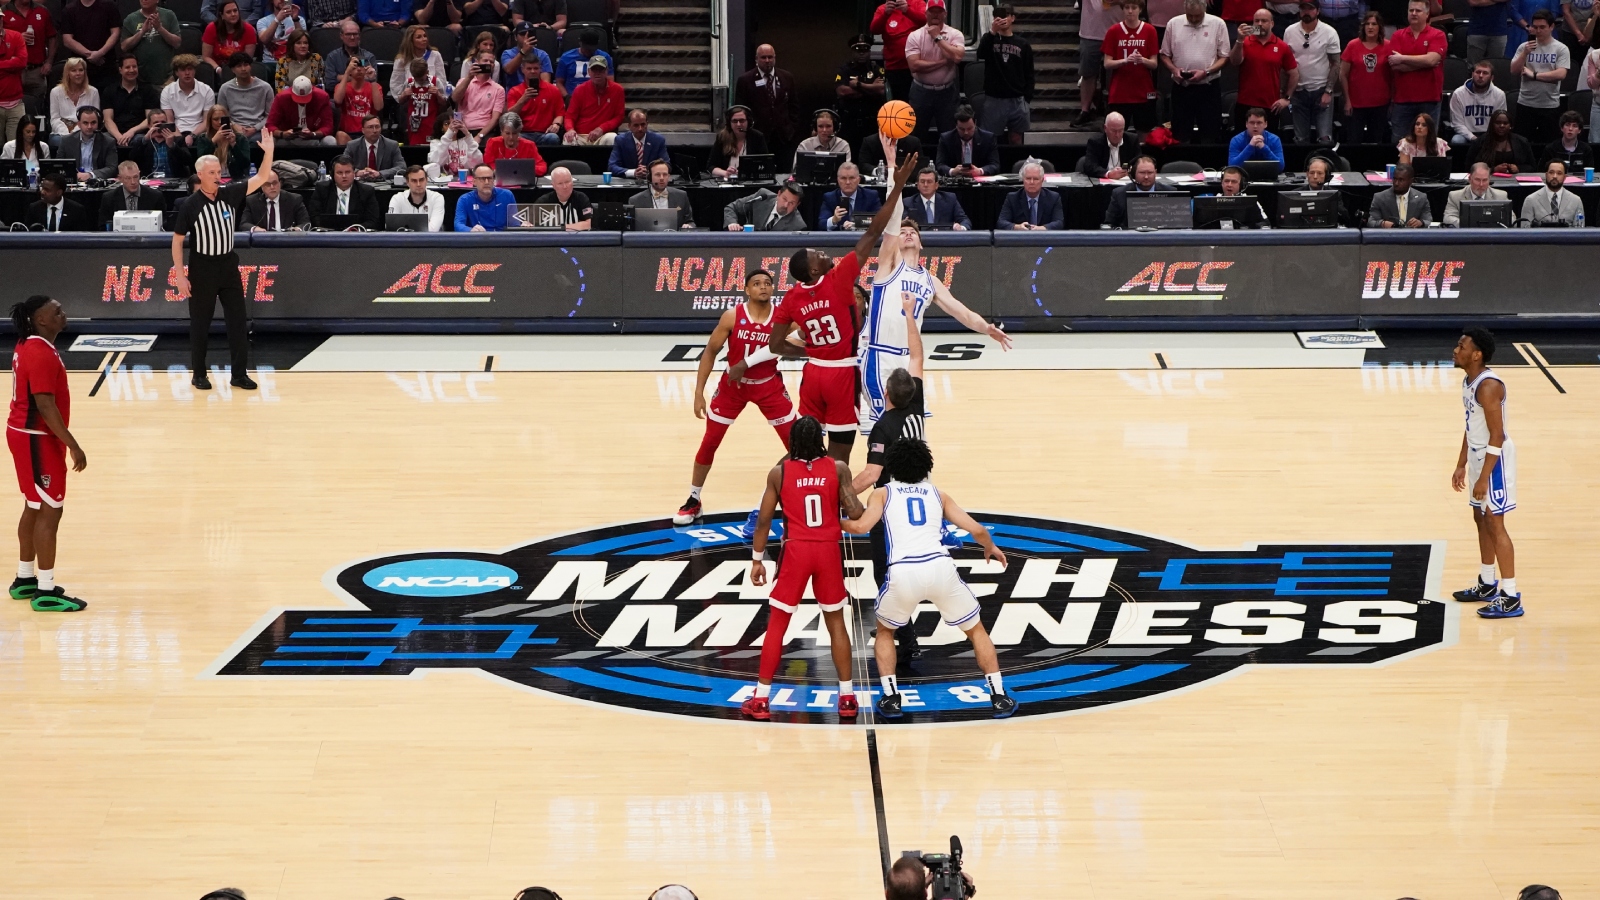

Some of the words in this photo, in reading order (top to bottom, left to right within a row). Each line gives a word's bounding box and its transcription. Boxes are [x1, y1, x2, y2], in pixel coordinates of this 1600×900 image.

[1528, 53, 1557, 64] DUKE
[1465, 105, 1494, 117] DUKE
[102, 265, 155, 302] NC
[164, 265, 279, 302] STE
[383, 263, 502, 294] ACC
[655, 257, 746, 292] NCAA
[1116, 261, 1235, 292] ACC
[1361, 261, 1465, 299] DUKE
[901, 279, 931, 300] DUKE
[801, 299, 830, 316] DIARRA
[737, 330, 749, 340] NC
[750, 331, 771, 343] STAT
[806, 314, 842, 346] 23
[796, 477, 827, 488] HORNE
[804, 494, 823, 528] 0
[906, 497, 927, 527] 0
[372, 576, 511, 588] NCAA
[947, 685, 991, 704] 8
